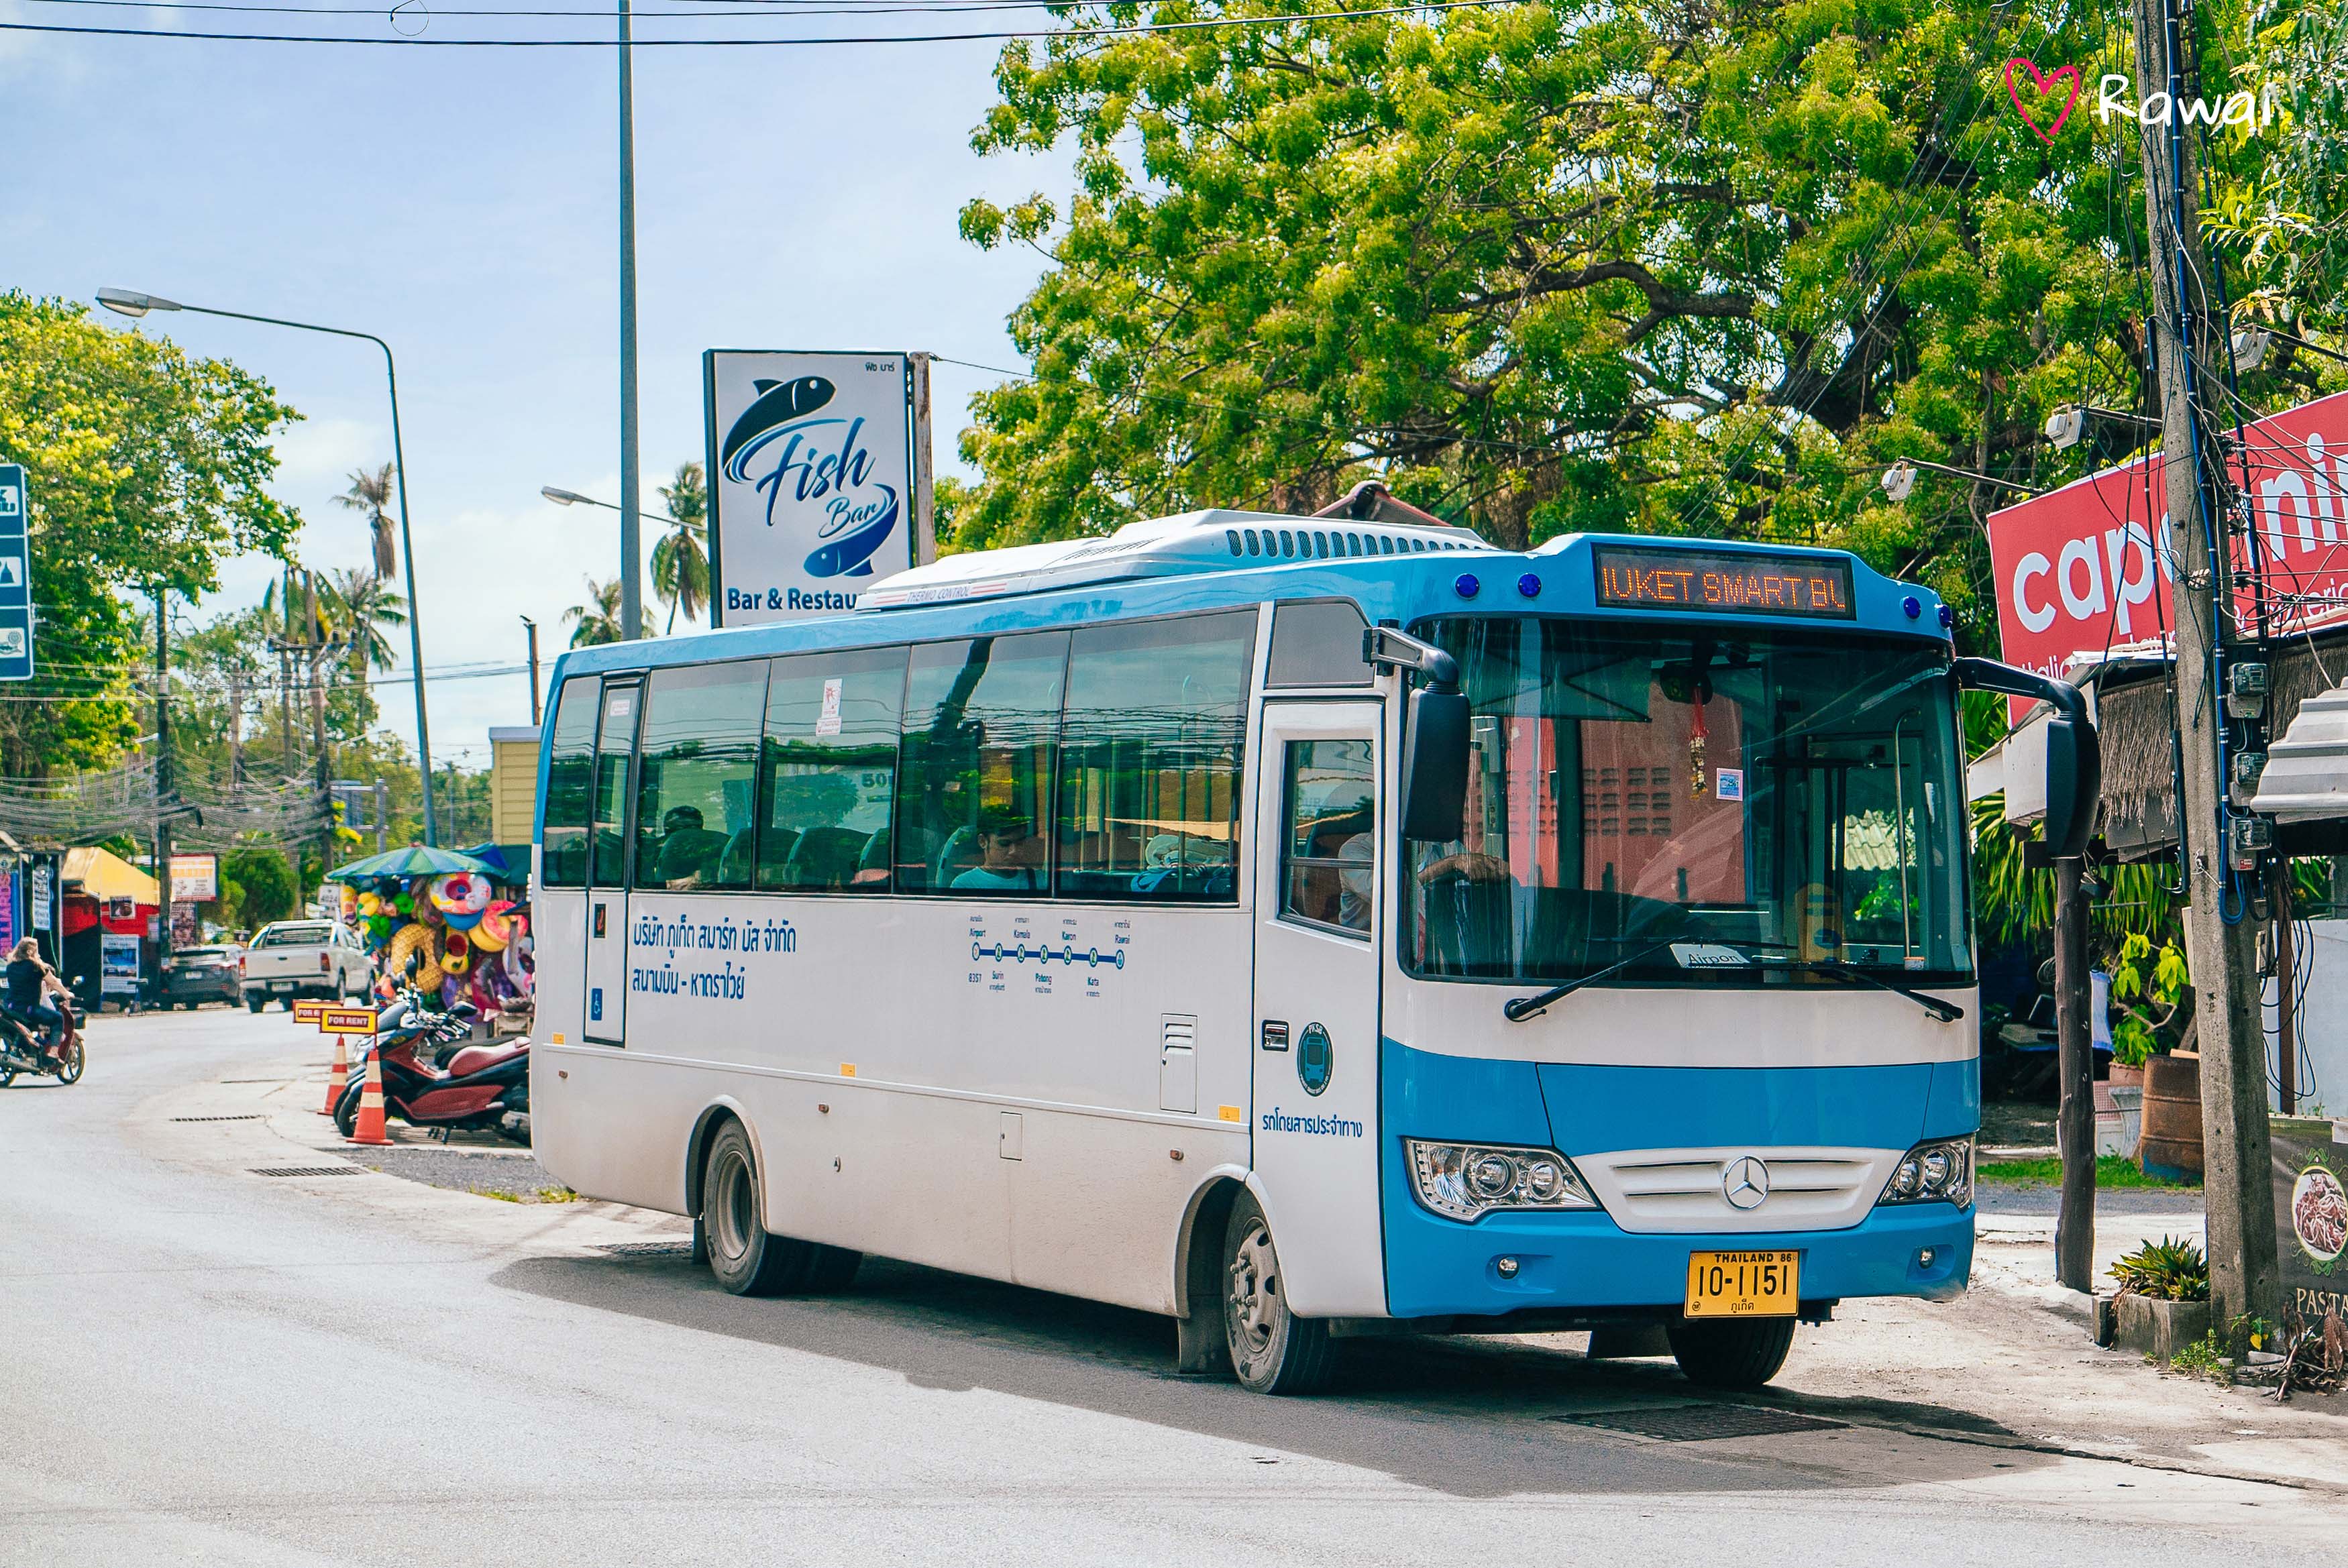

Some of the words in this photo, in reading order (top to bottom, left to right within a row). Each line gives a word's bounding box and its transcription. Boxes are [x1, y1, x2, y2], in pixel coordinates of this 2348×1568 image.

[755, 417, 876, 527] Fish
[818, 496, 879, 539] Bar
[728, 588, 761, 610] Bar
[767, 588, 783, 610] &
[788, 587, 857, 610] Restau
[1602, 567, 1693, 602] UKET
[1703, 573, 1802, 606] SMART
[634, 915, 664, 946] บริษัท
[668, 914, 695, 959] ภูเก็ต
[698, 917, 737, 950] สมาร์ท
[742, 919, 760, 952] บัส
[764, 919, 796, 952] จำกัด
[1062, 931, 1076, 941] Karon
[1115, 934, 1130, 944] Rawai
[633, 964, 679, 995] สนามบิน
[691, 961, 745, 999] หาดราไวย์
[328, 1016, 344, 1025] FOR
[346, 1017, 368, 1025] RENT
[1263, 1107, 1363, 1138] รถโดยสารประจำทาง
[1715, 1253, 1774, 1263] THAILAND
[1780, 1253, 1792, 1262] 86
[1699, 1266, 1787, 1296] 10-1151
[1731, 1298, 1754, 1313] ภูเก็ต
